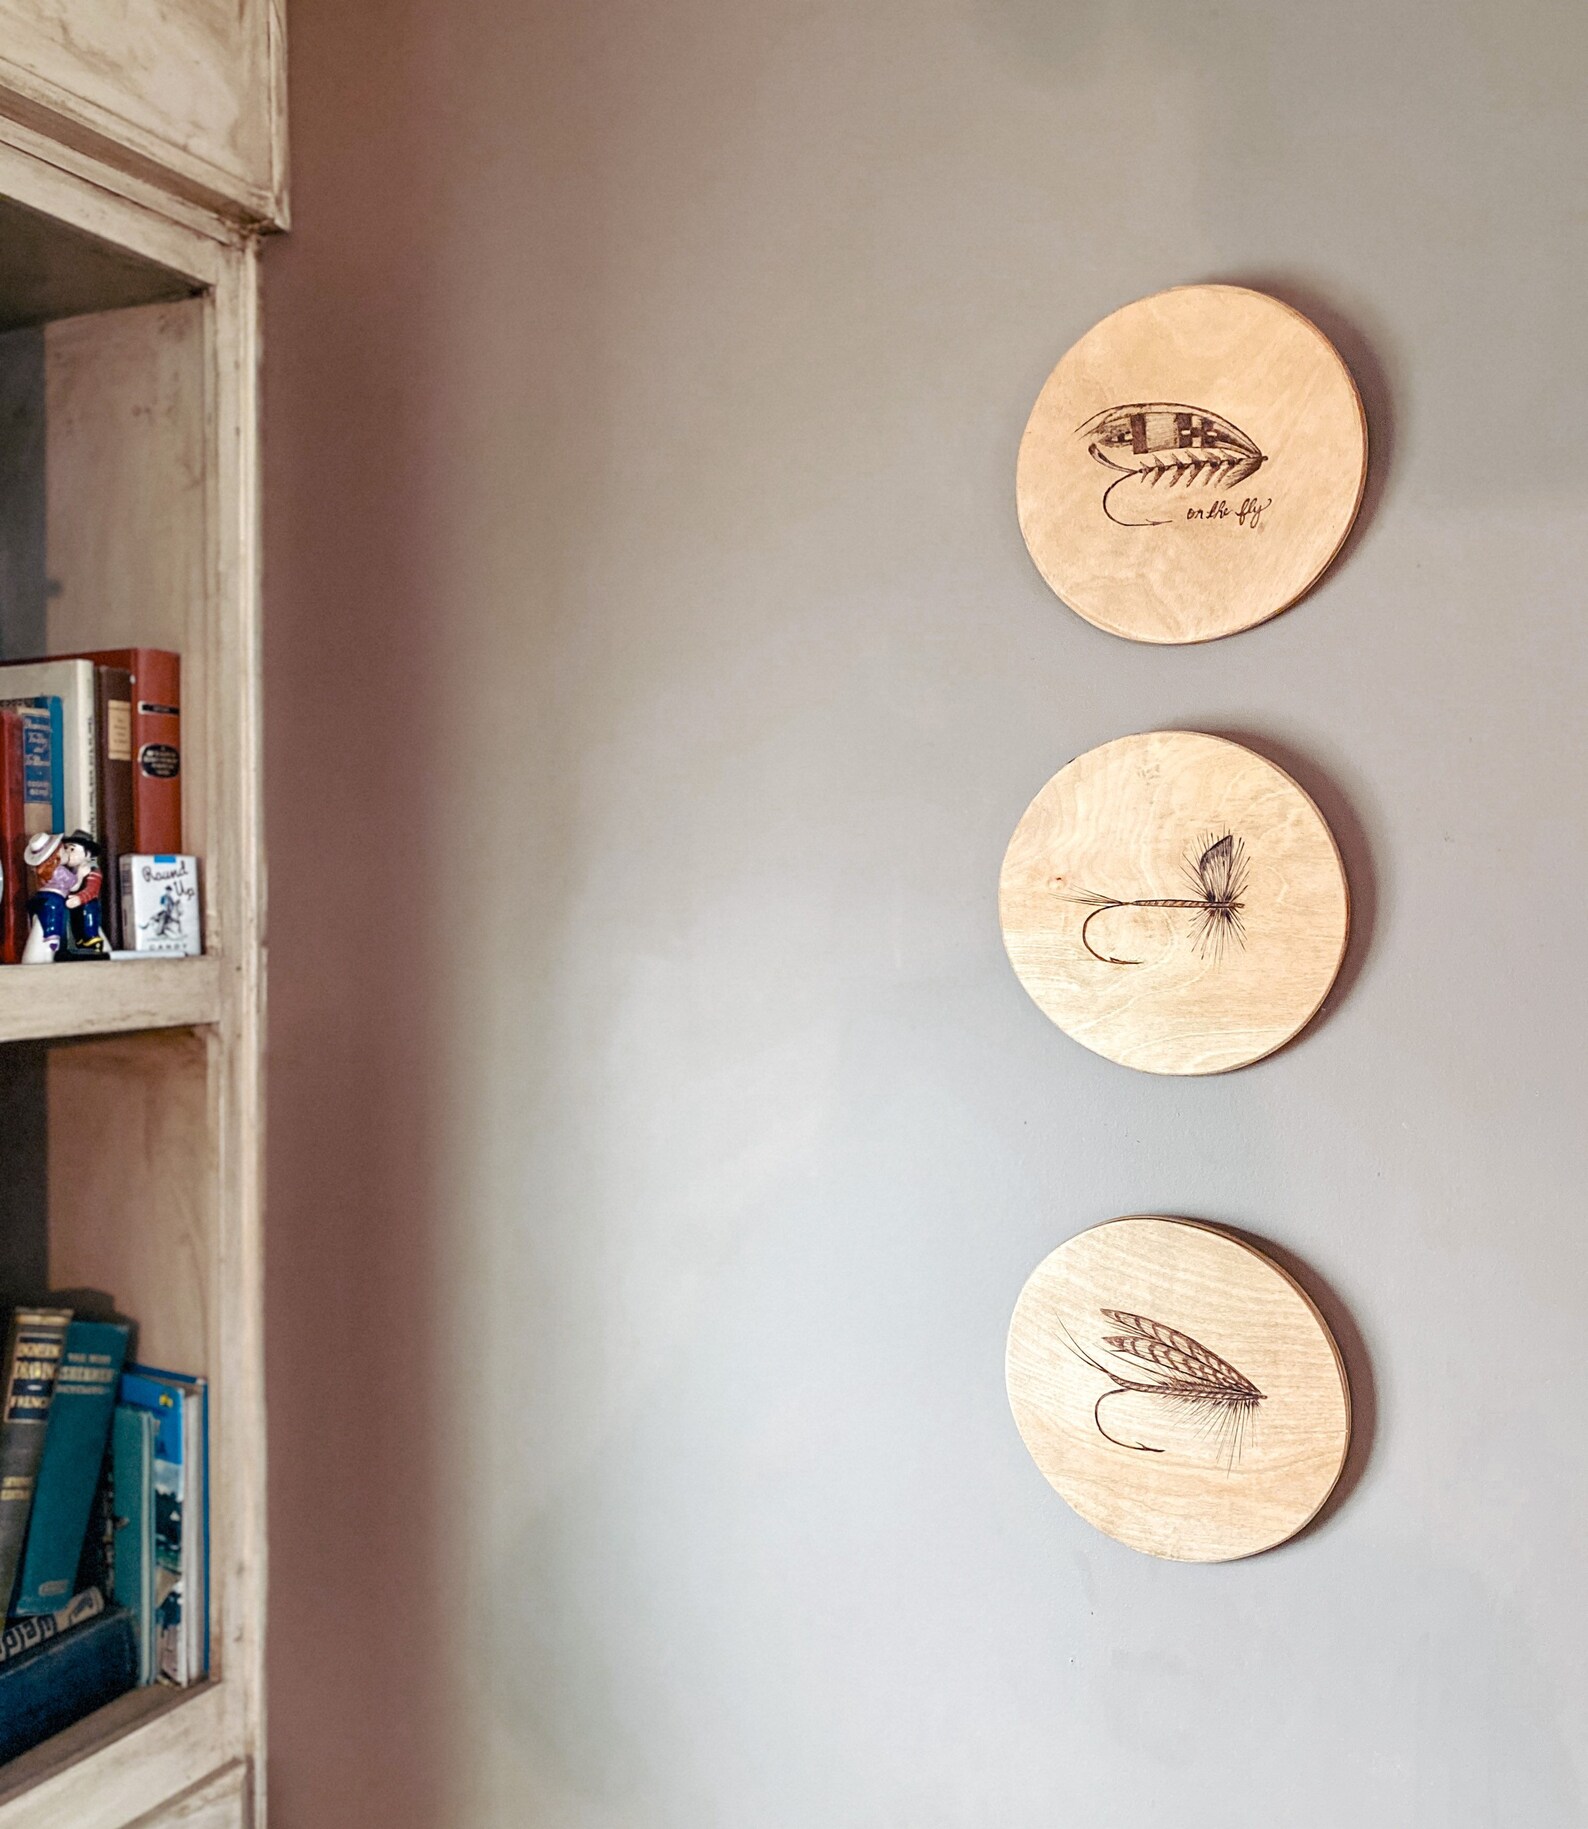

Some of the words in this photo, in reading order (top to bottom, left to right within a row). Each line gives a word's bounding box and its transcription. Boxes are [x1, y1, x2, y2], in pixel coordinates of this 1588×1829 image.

[1186, 508, 1203, 519] on
[1206, 500, 1233, 519] the
[1235, 498, 1272, 528] fly
[142, 861, 188, 882] Round
[173, 880, 195, 901] Up
[148, 943, 188, 951] CANDY
